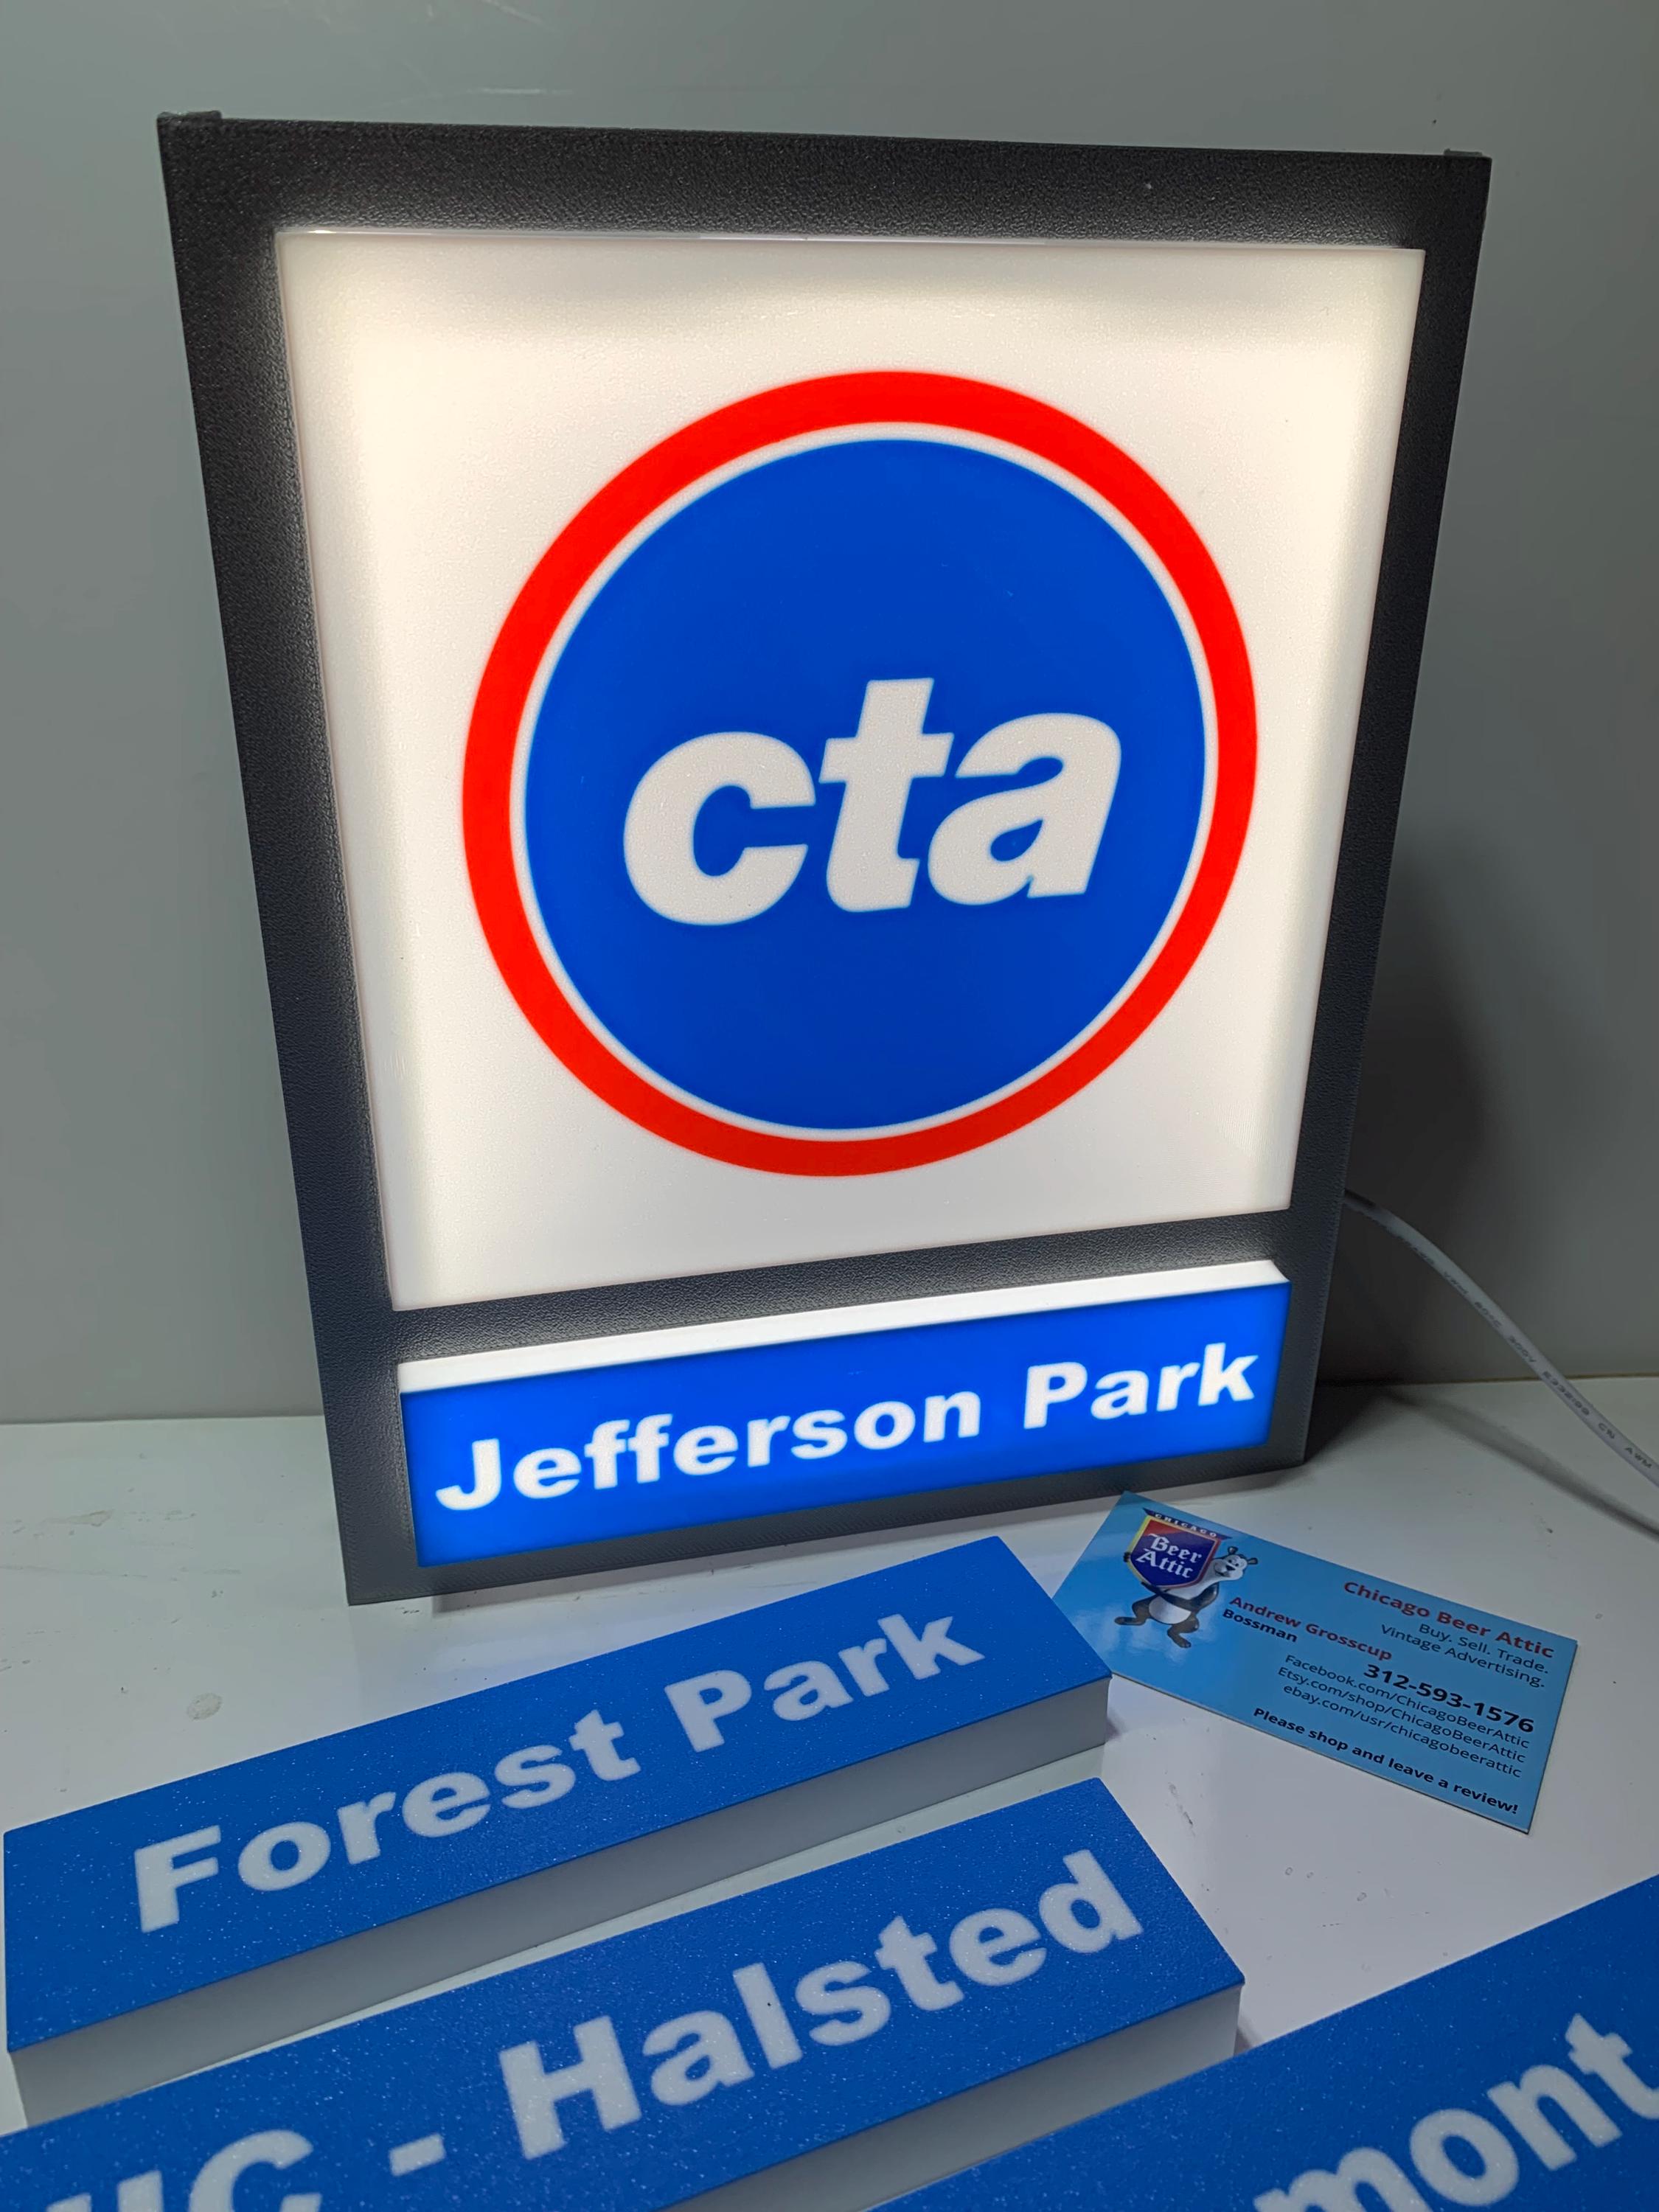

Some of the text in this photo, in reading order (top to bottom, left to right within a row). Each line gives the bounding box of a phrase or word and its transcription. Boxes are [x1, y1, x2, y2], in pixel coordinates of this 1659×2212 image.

[624, 678, 1121, 925] cta
[436, 1343, 1256, 1511] Jefferson Park
[1624, 1447, 1652, 1469] AWM
[1147, 1533, 1203, 1564] Beer
[1155, 1513, 1217, 1538] CHICAGO
[1135, 1548, 1194, 1579] Attic
[1222, 1608, 1298, 1643] Bossman
[1229, 1596, 1393, 1661] Andrew Grosscup
[1344, 1581, 1555, 1658] Chicago Beer Attic
[1381, 1624, 1545, 1688] Vintage Advertising.
[1419, 1623, 1548, 1674] Buy. Sell. Trade.
[1277, 1666, 1526, 1763] Etsy.com/shop/ChicagoBeerAttic
[1283, 1686, 1523, 1778] ebay.com/usr/chicagobeerattic
[1284, 1655, 1530, 1748] Facebook.com/ChicagoBeerAttic
[1363, 1663, 1534, 1733] 312-593-1576
[133, 1615, 982, 1933] Forest Park
[1253, 1708, 1519, 1815] Please shop and leave a review!
[498, 1849, 1142, 2159] Halsted
